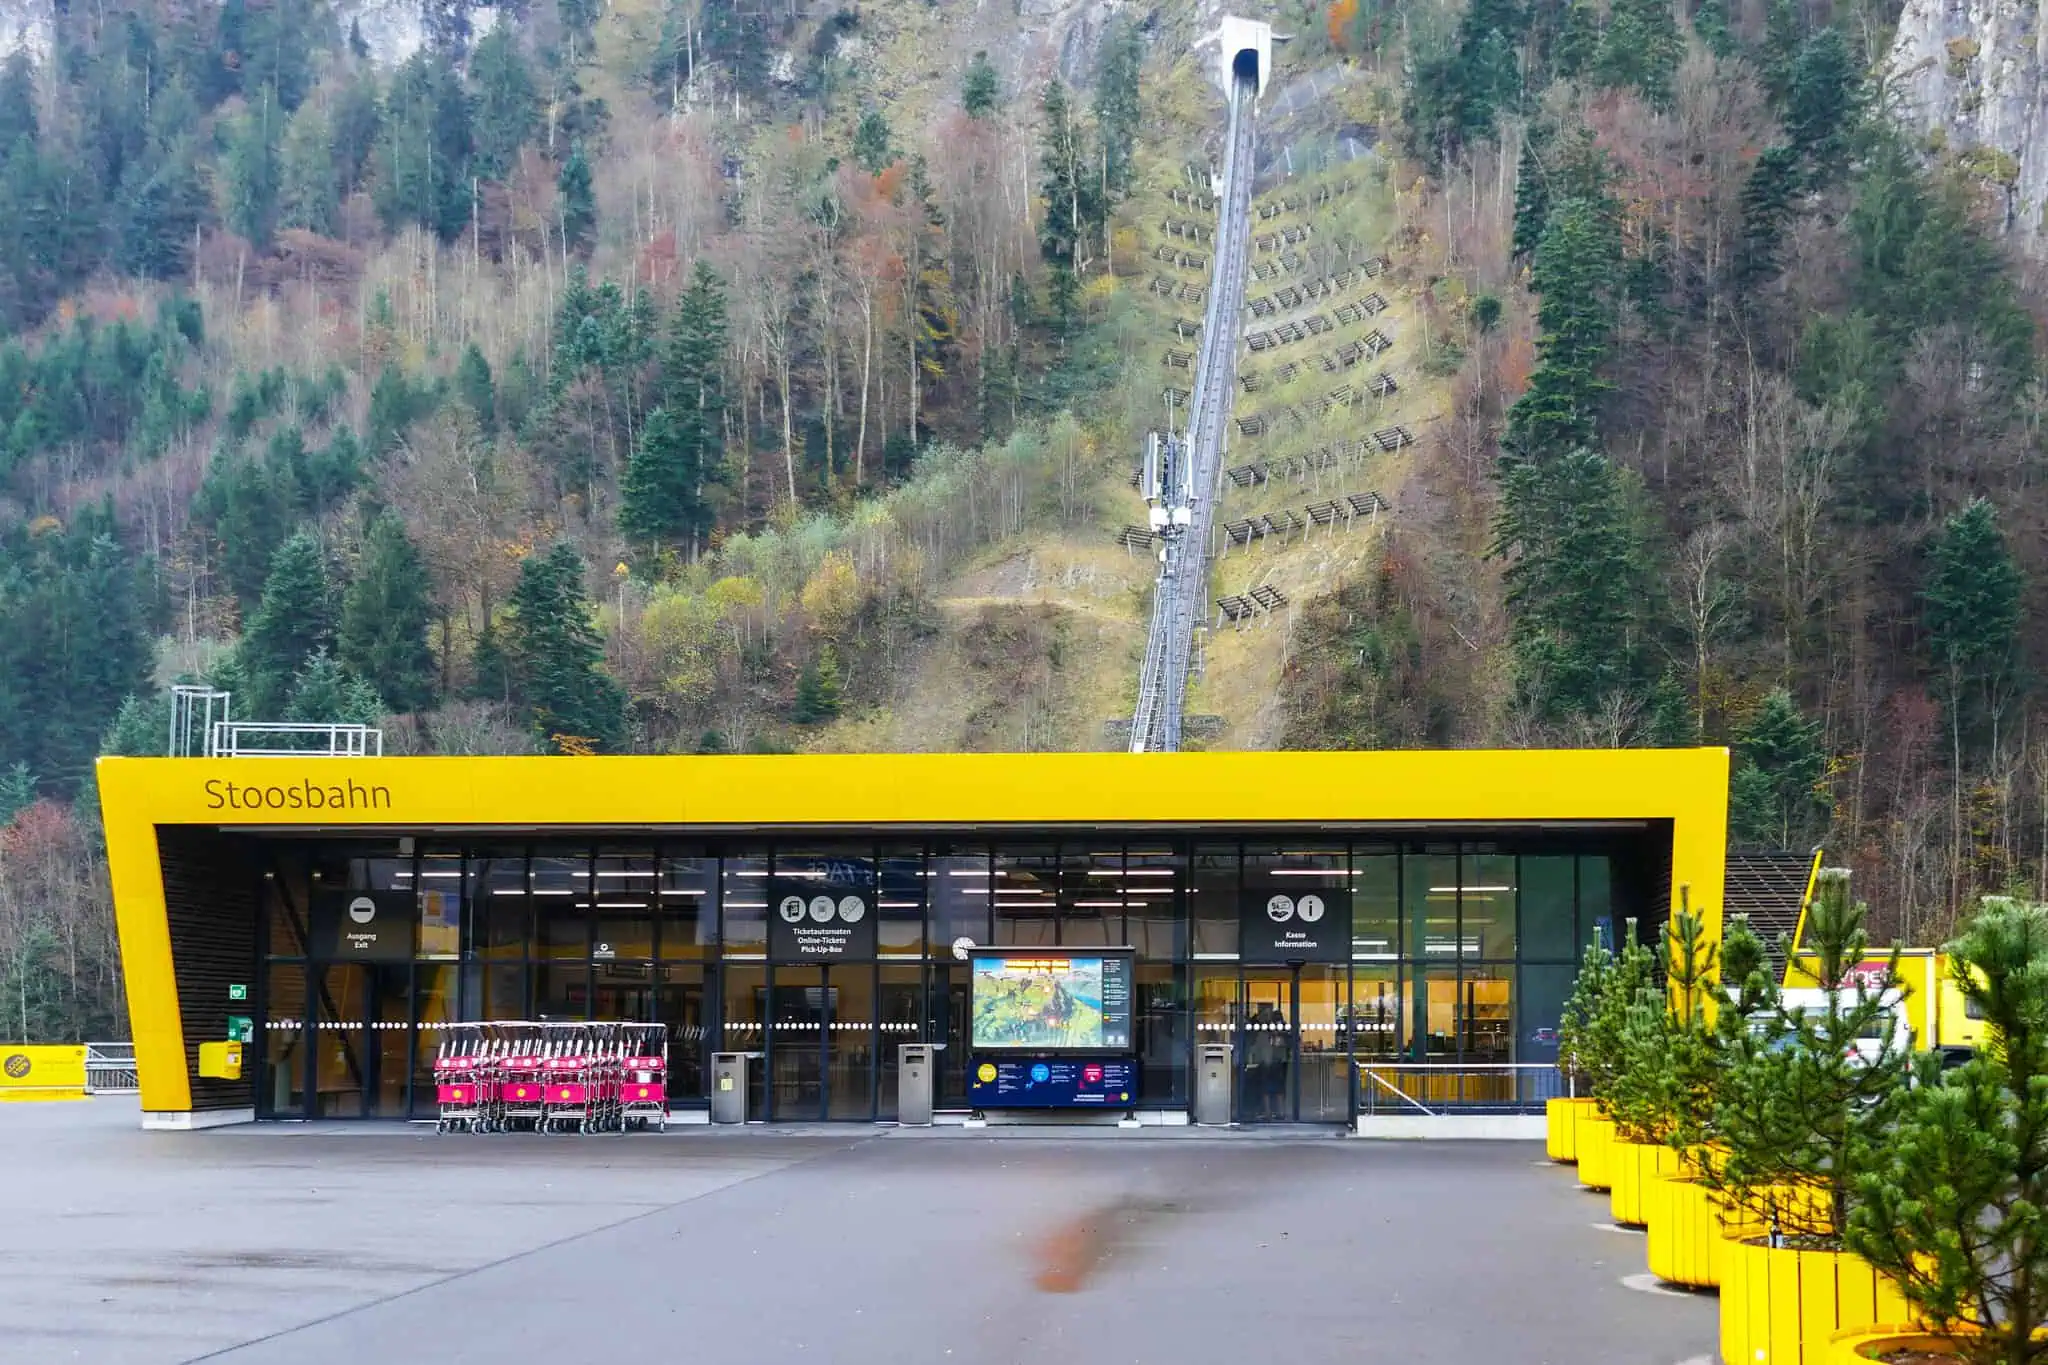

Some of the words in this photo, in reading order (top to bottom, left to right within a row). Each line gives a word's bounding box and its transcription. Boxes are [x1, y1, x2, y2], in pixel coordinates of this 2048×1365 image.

[204, 777, 391, 809] Stoosbahn
[793, 928, 852, 936] Ticketautomaten
[346, 932, 377, 942] Ausgang
[798, 936, 847, 944] Online-Tickets
[354, 941, 369, 949] Exit
[1274, 940, 1318, 948] Information
[801, 945, 843, 955] Pick-Up-Box
